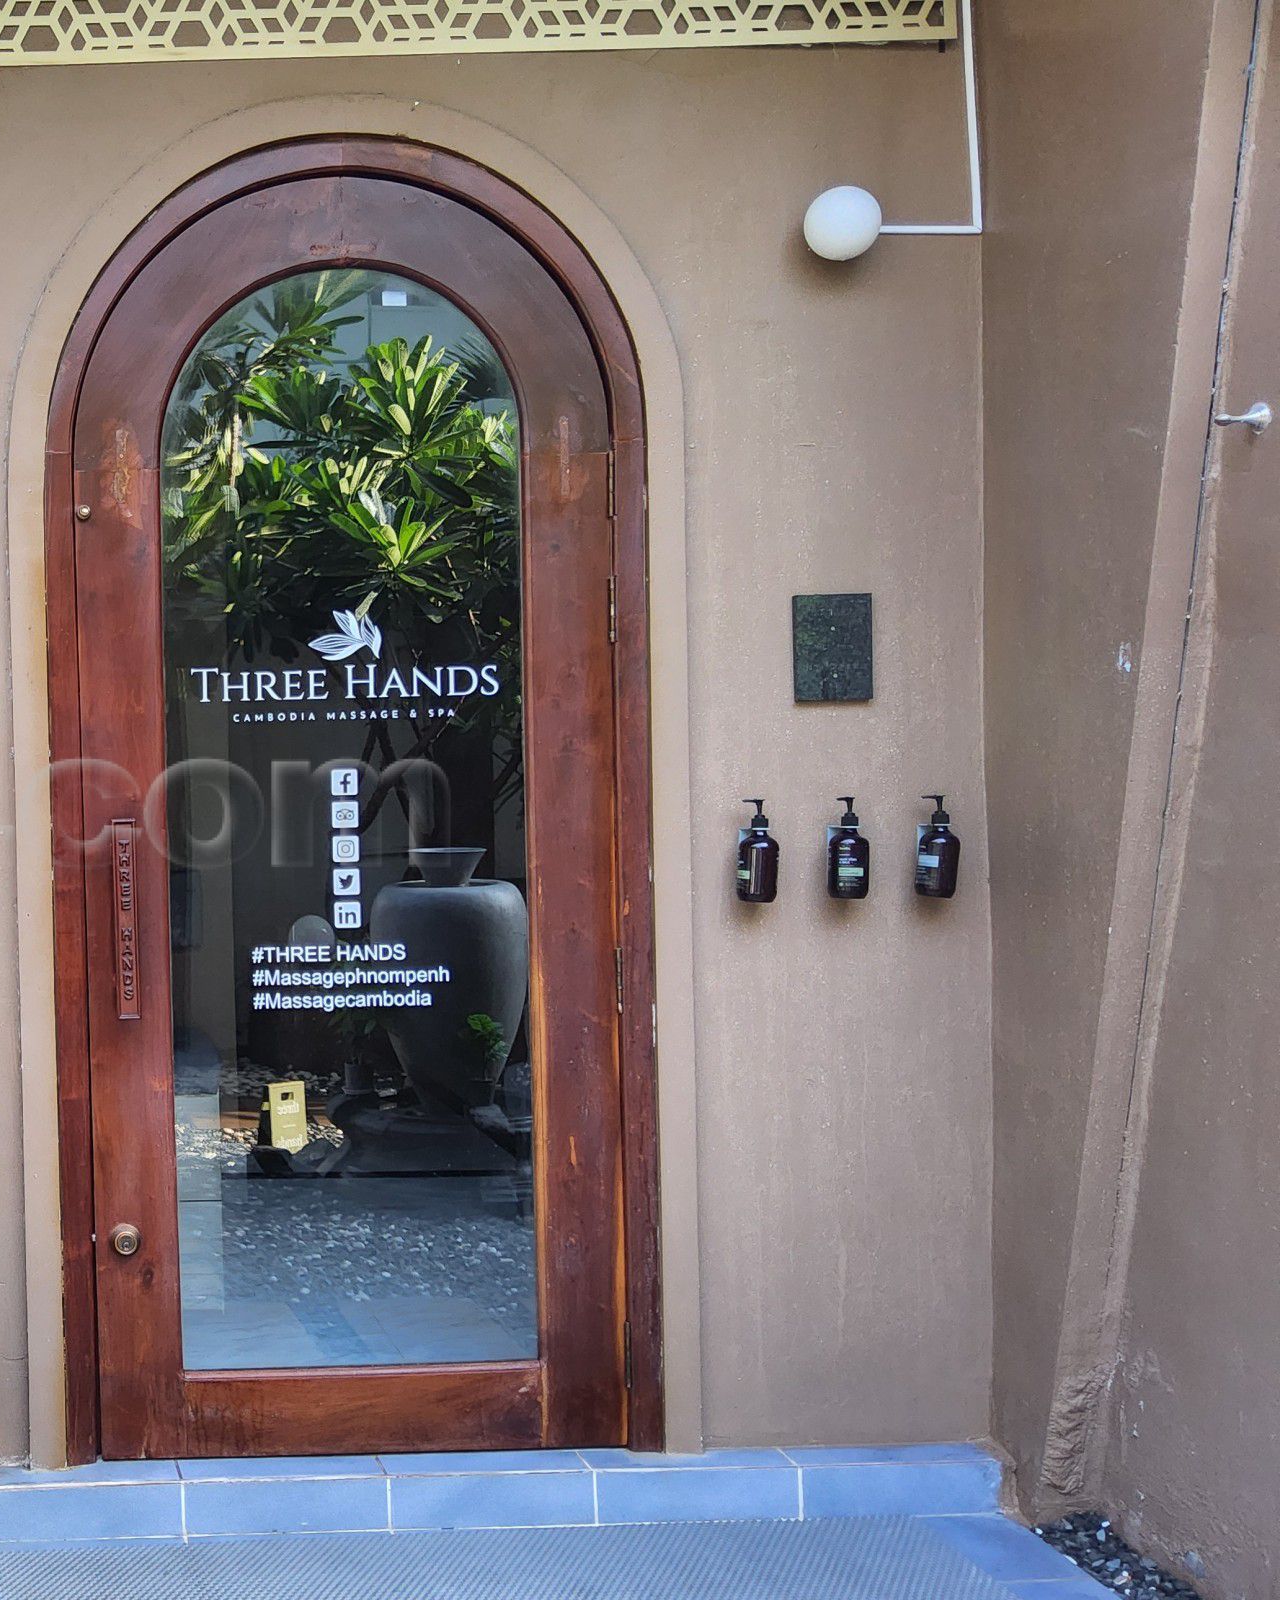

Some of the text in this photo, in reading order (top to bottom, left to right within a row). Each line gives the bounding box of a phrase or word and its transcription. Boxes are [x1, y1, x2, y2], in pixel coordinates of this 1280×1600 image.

[190, 664, 500, 703] THREE HANDS
[232, 708, 456, 723] CAMBODIA MASSAGE & SPA
[118, 839, 133, 1000] THREE HANDS
[252, 944, 406, 963] #THREE HANDS
[252, 966, 450, 987] #Massagephnompenh
[253, 990, 432, 1011] #Massagecambodia
